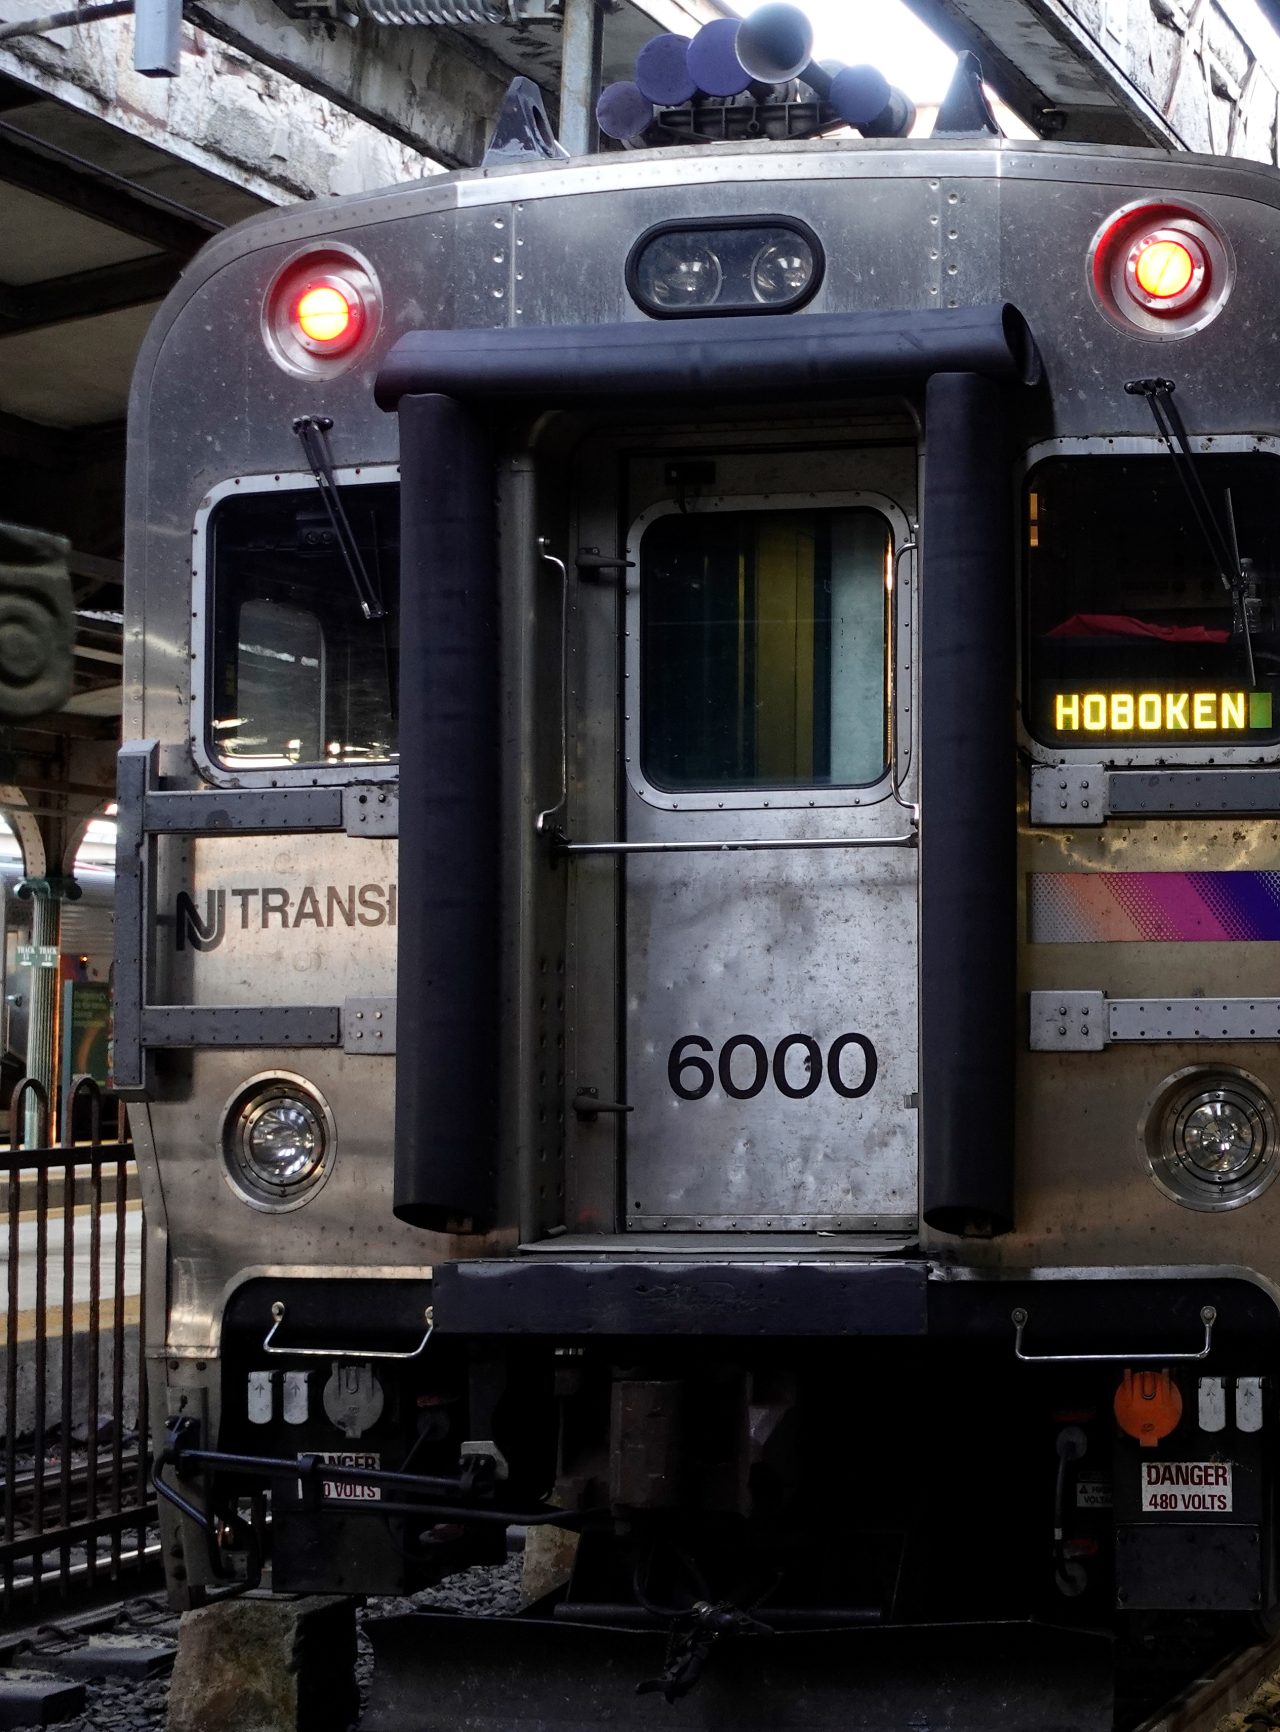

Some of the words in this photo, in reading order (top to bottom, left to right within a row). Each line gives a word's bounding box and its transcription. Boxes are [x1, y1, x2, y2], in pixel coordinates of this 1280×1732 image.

[1056, 692, 1245, 731] HOBOKEN
[176, 889, 226, 952] NJ
[17, 946, 36, 955] TRACK
[39, 946, 57, 955] TRACK
[667, 1032, 878, 1101] 6000
[1147, 1465, 1228, 1486] DANGER
[1149, 1494, 1178, 1510] 480
[1181, 1494, 1227, 1510] VOLTS
